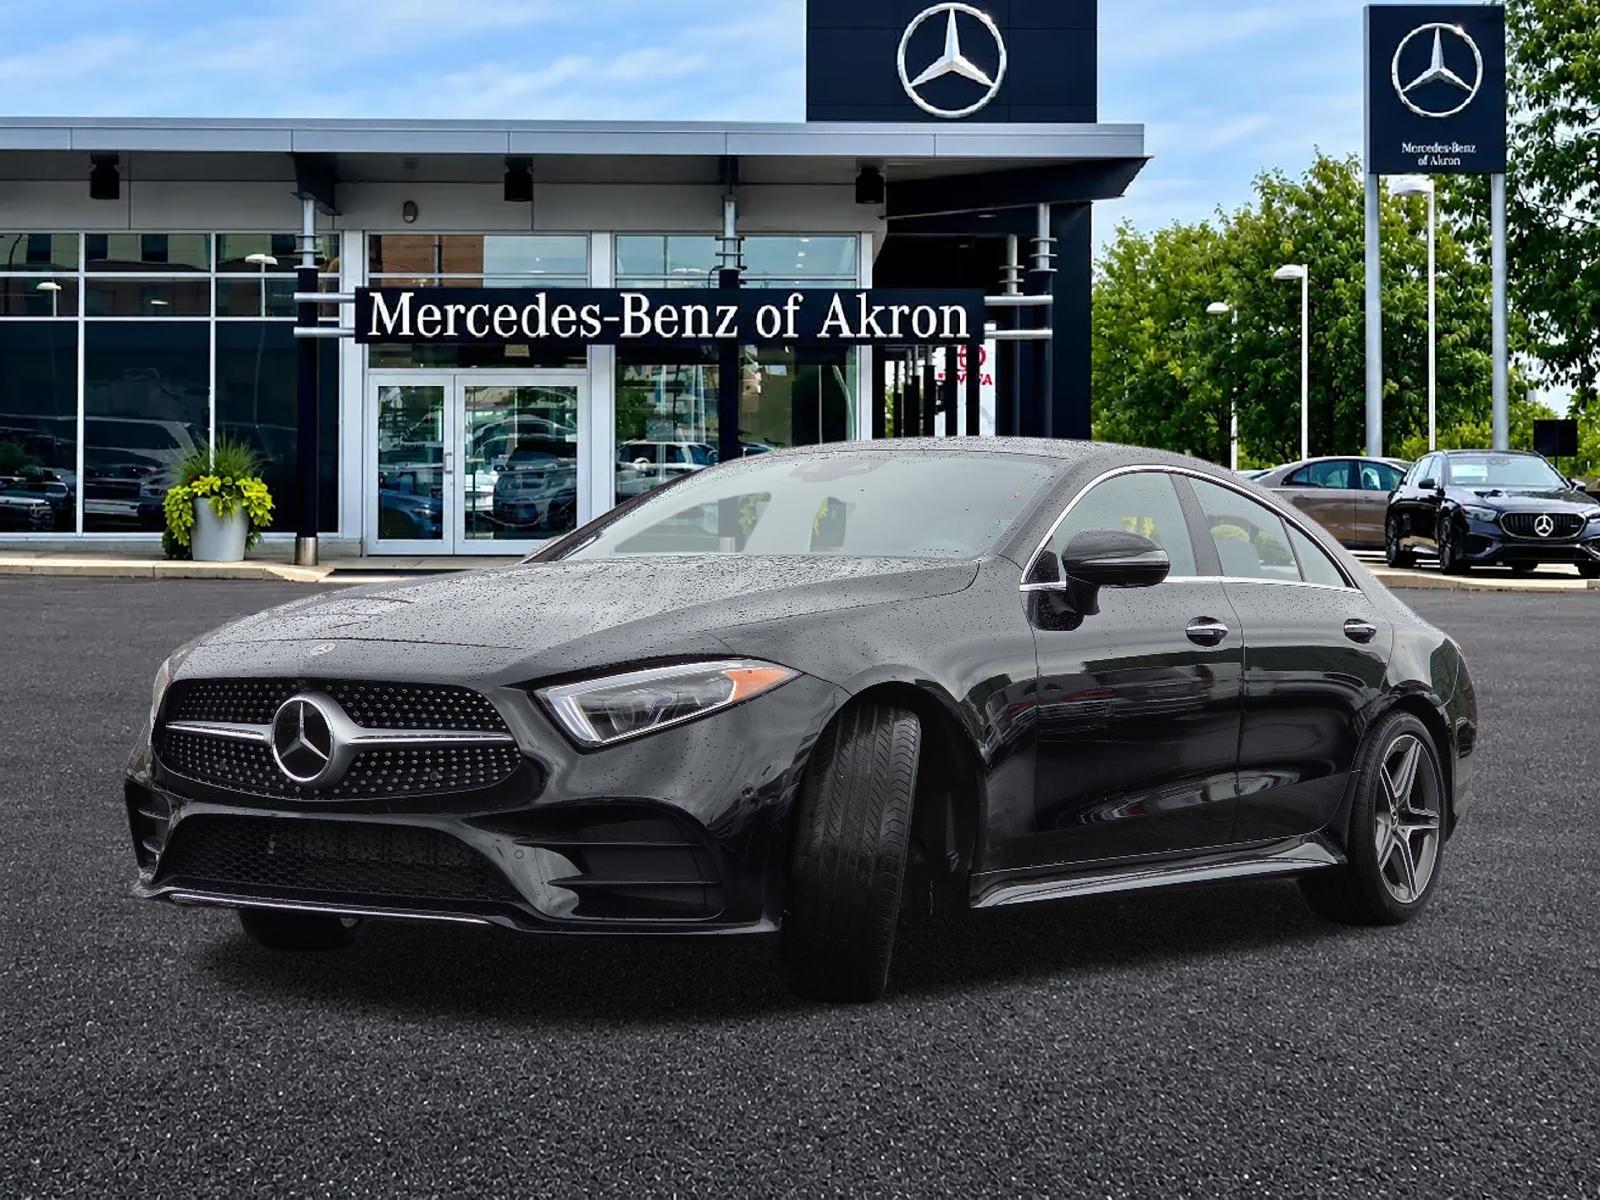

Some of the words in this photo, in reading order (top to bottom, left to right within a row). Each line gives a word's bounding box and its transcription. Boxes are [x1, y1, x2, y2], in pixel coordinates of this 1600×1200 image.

[1401, 142, 1476, 153] Mercedes-Benz
[1418, 154, 1428, 165] of
[1430, 154, 1461, 165] Akron
[367, 291, 738, 338] Mercedes-Benz
[755, 291, 804, 339] of
[817, 291, 970, 339] Akron
